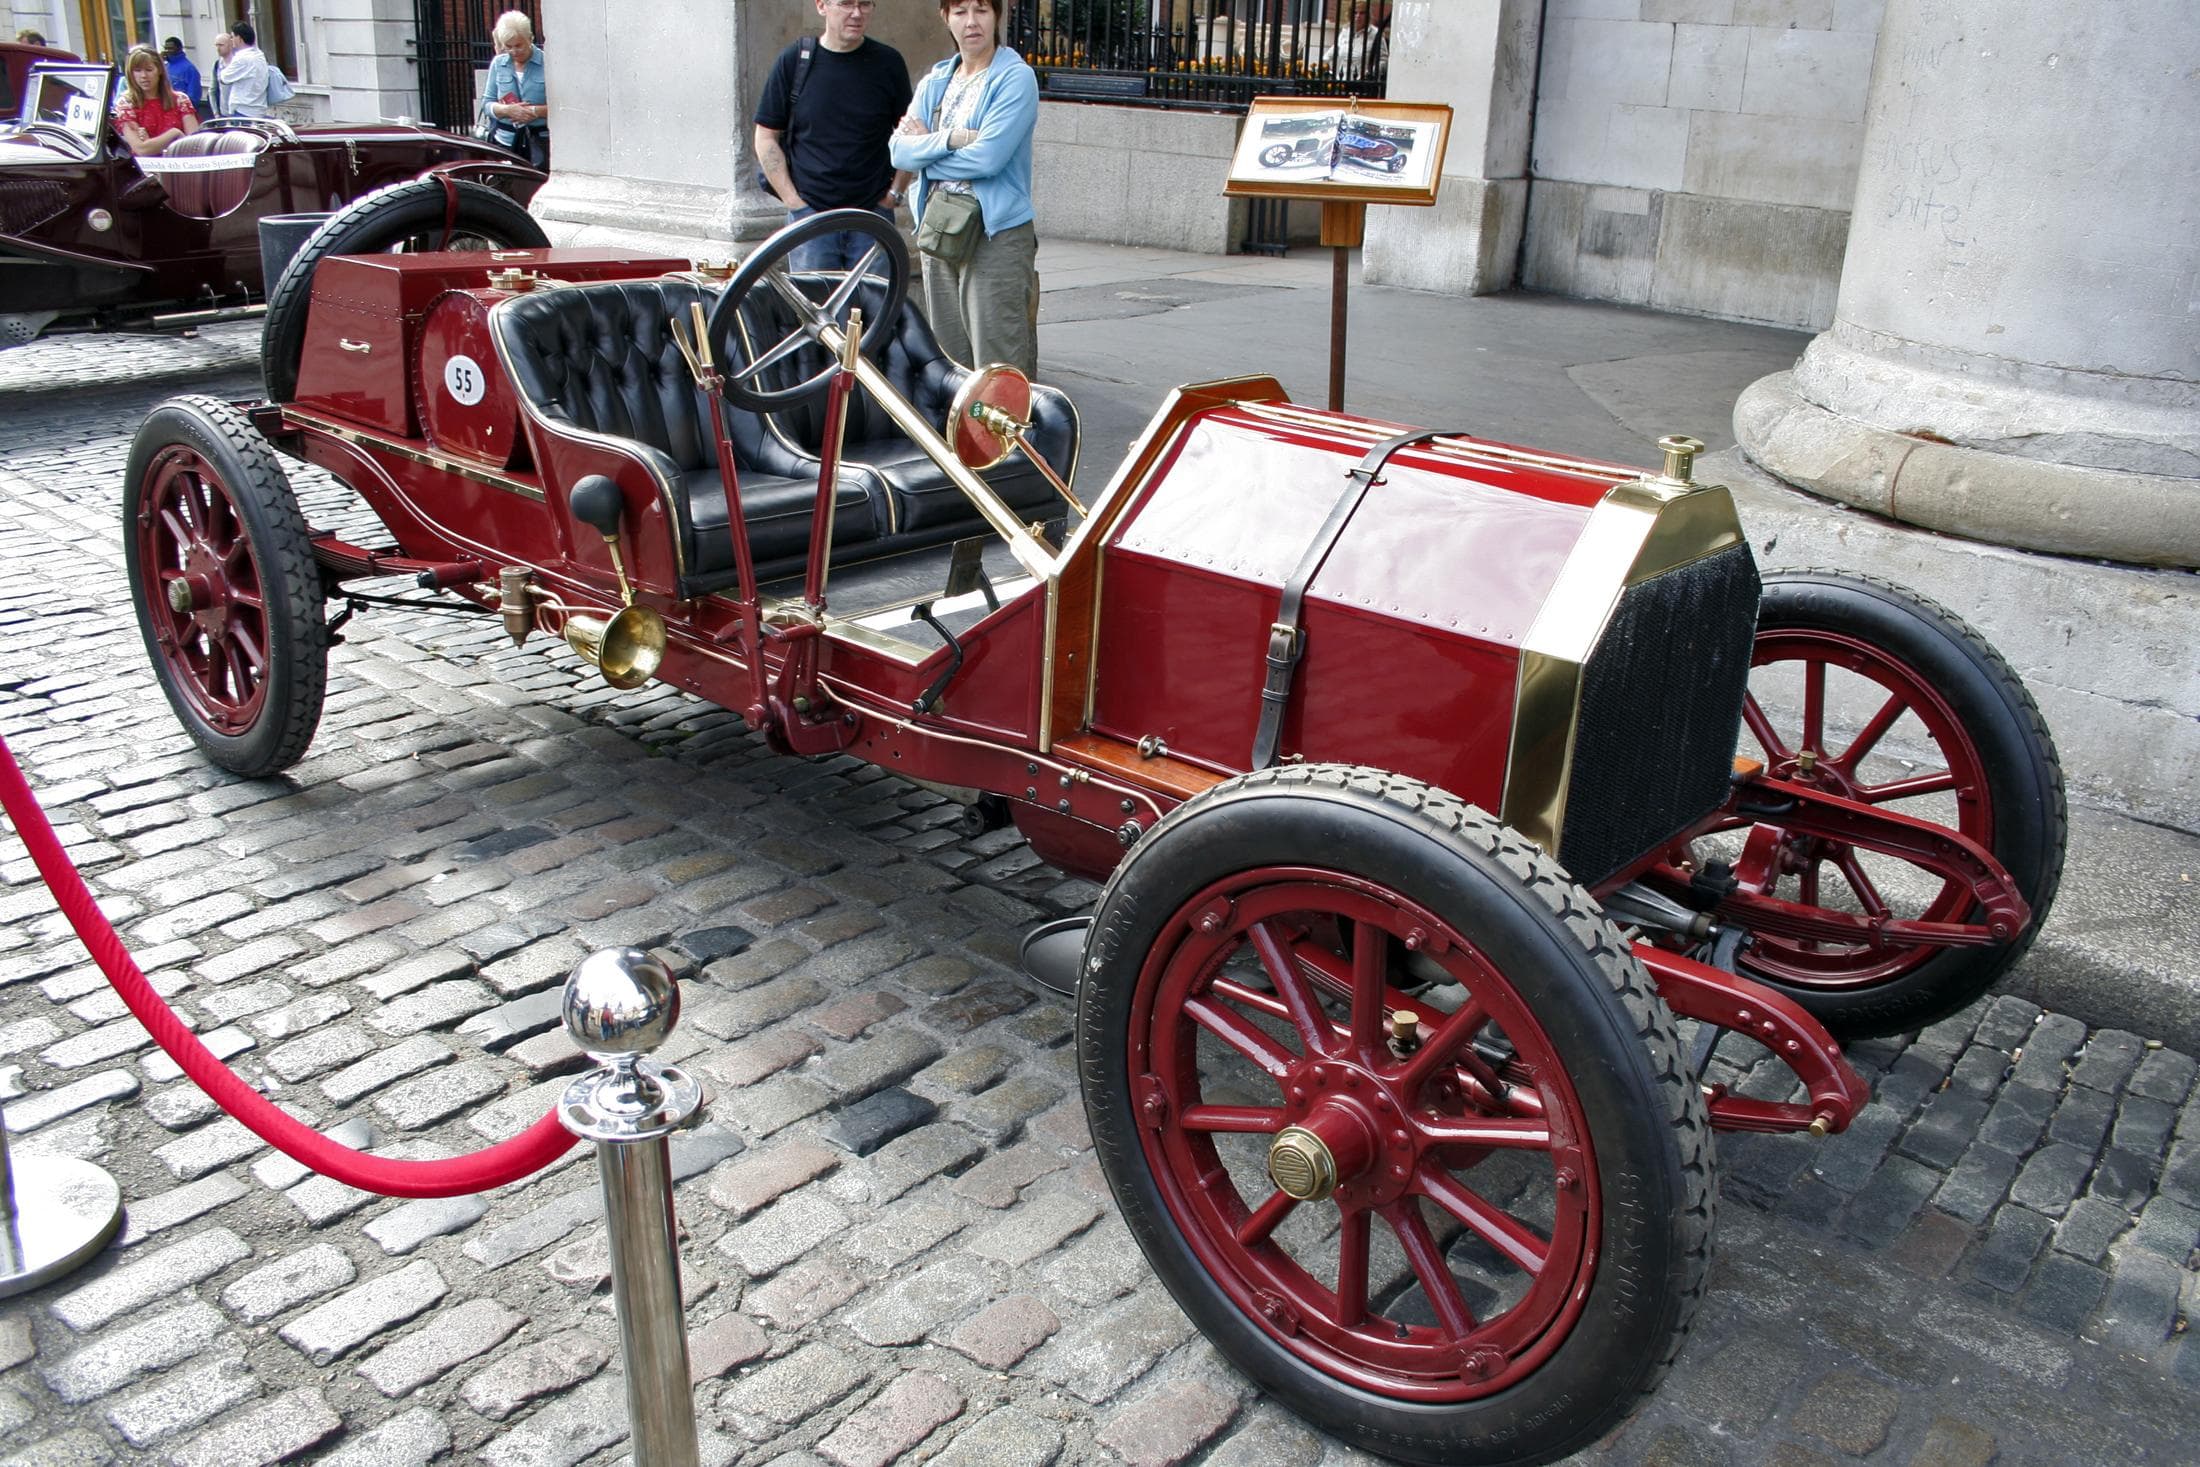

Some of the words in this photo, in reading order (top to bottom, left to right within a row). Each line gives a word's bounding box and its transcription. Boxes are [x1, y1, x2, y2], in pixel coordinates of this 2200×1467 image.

[72, 104, 81, 119] 8
[141, 161, 166, 170] ambda
[455, 367, 472, 393] 55
